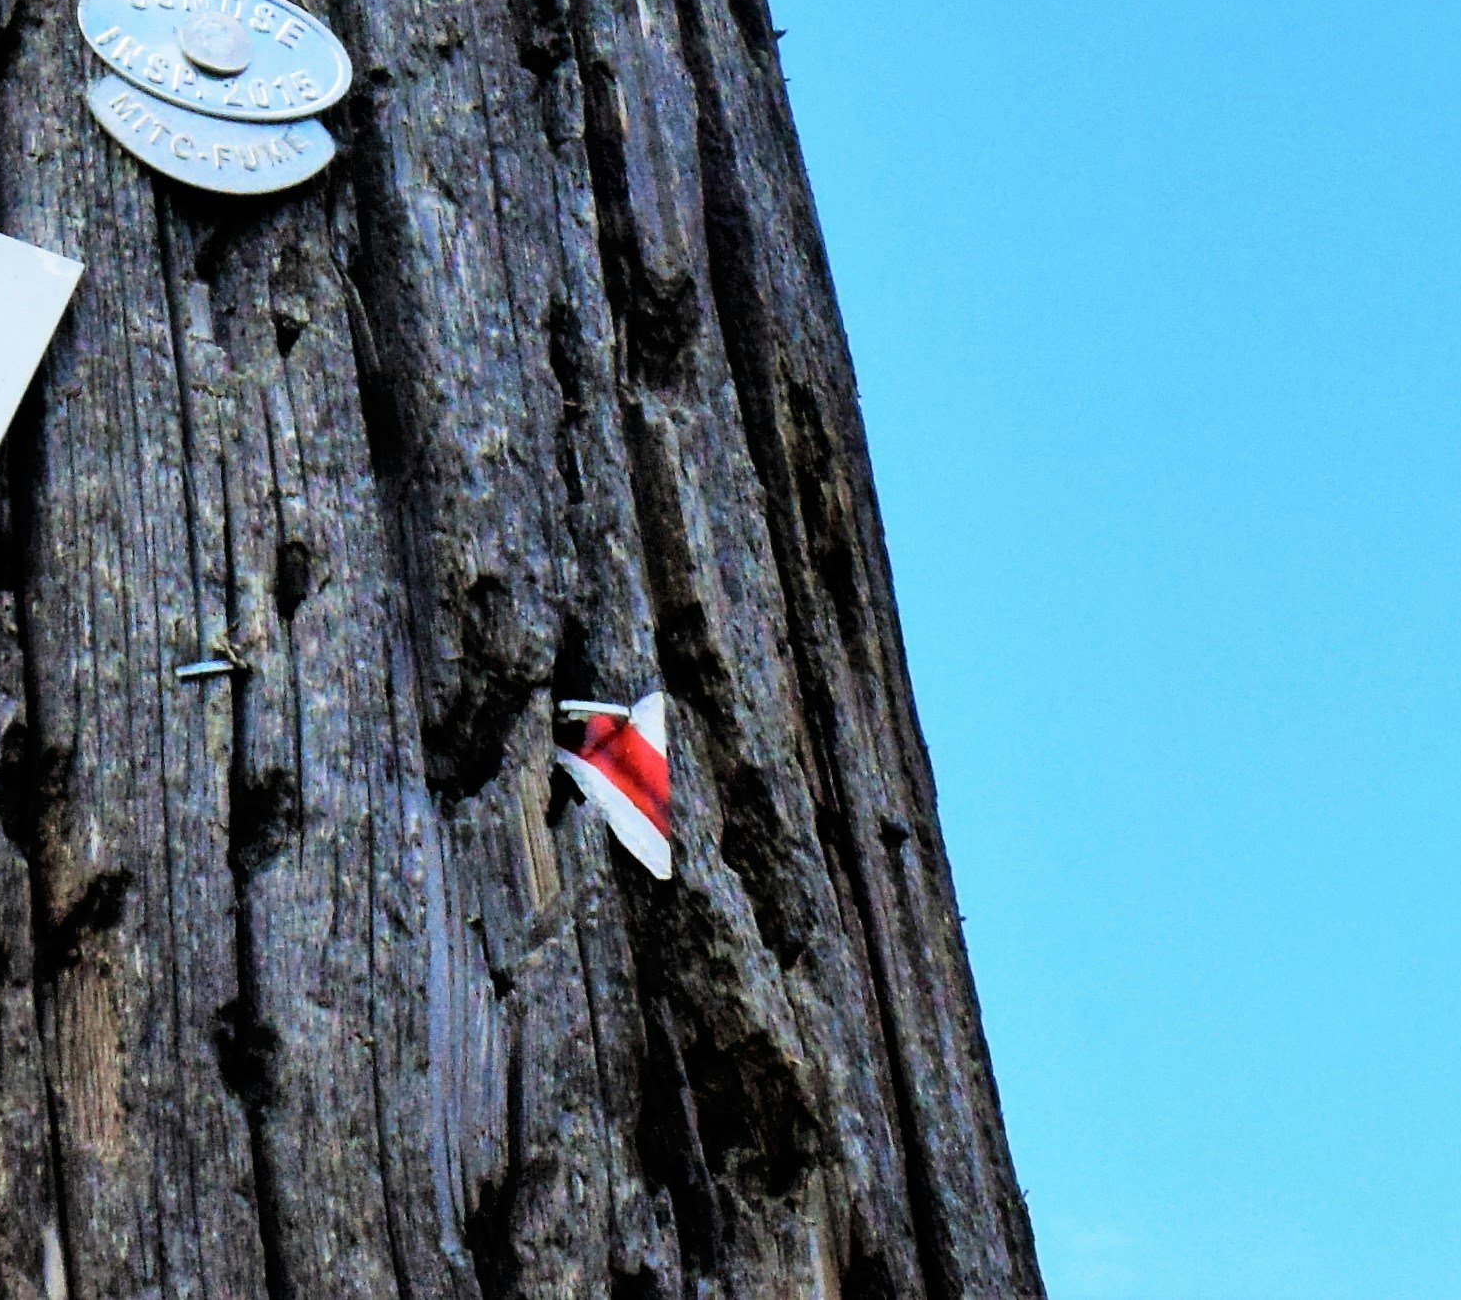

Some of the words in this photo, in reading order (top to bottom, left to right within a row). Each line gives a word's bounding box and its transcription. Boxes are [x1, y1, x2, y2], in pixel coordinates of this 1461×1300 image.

[95, 25, 206, 101] INSP.
[222, 69, 322, 110] 2015
[108, 89, 313, 173] MITC-FUME
